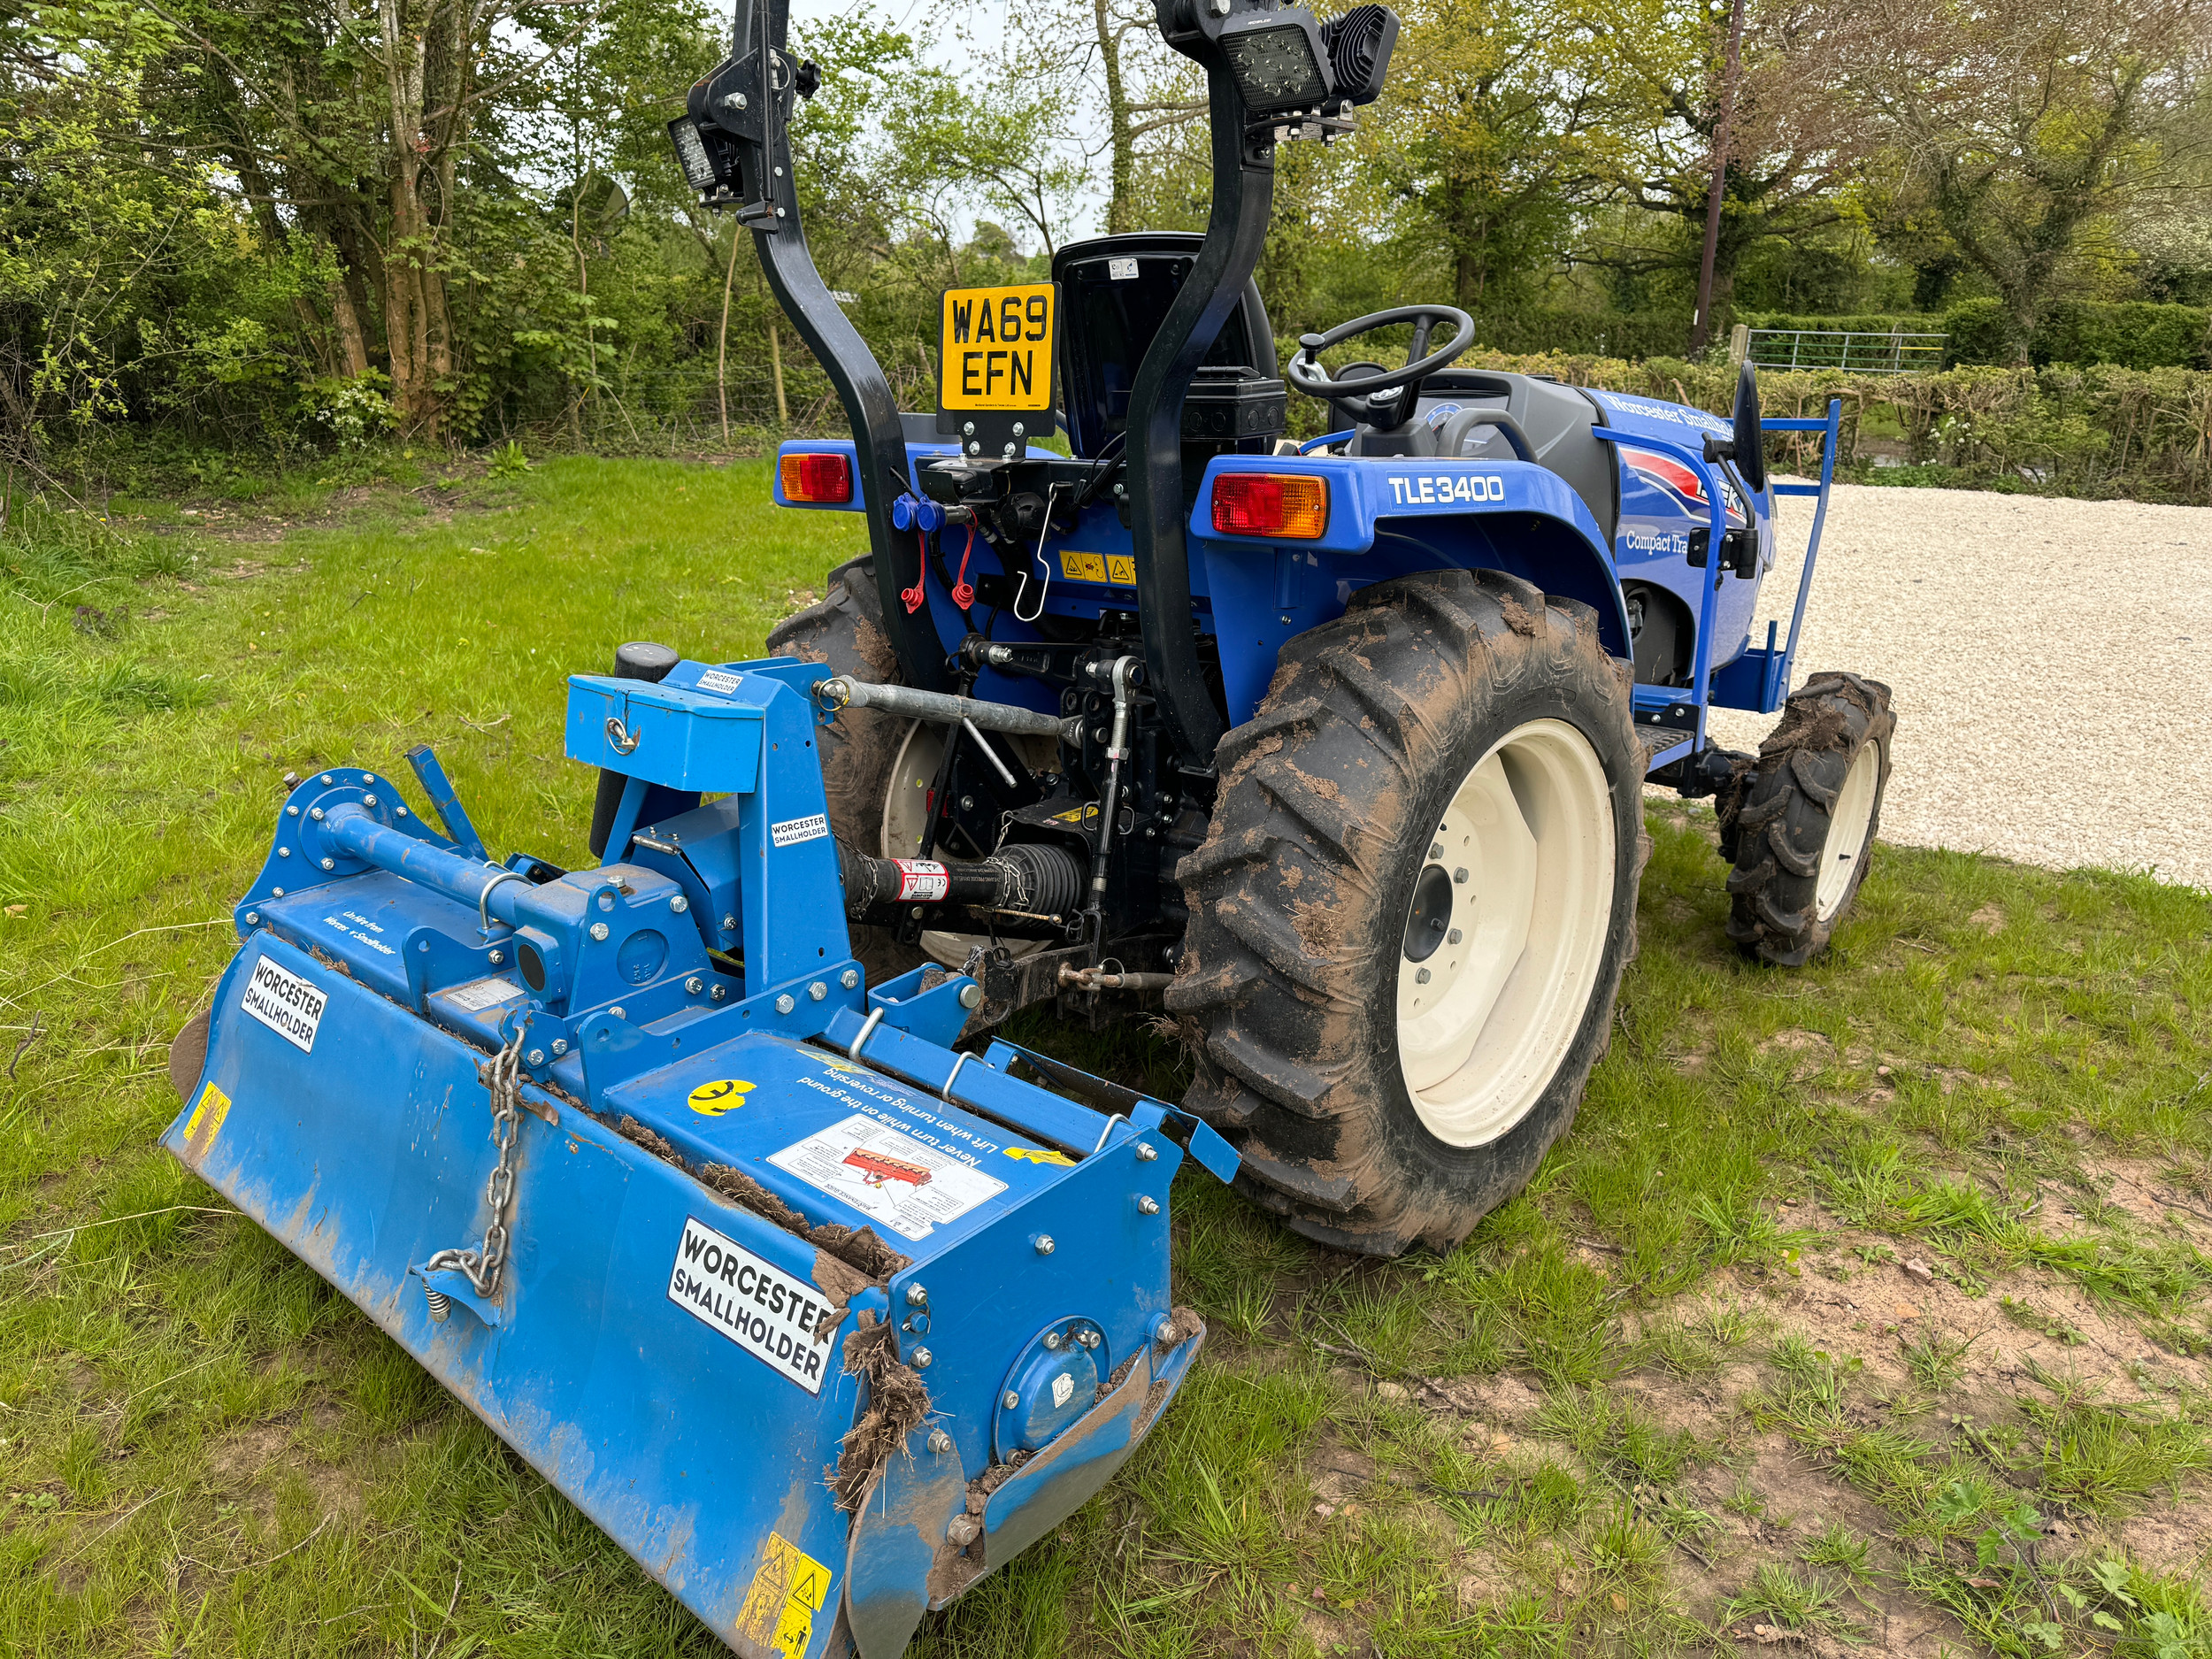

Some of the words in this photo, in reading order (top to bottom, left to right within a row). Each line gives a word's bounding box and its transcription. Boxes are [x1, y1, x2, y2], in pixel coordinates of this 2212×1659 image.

[952, 295, 1048, 344] WA69
[962, 349, 1033, 396] EFN
[1601, 393, 1682, 426] Worcester
[1387, 475, 1505, 504] TLE3400
[1625, 530, 1672, 556] Compact
[1672, 534, 1687, 554] Tra
[698, 679, 735, 692] SMALLHOLDER
[704, 672, 741, 685] WORCESTER
[772, 817, 825, 834] WORCESTER
[774, 826, 826, 844] SMALLHOLDER
[255, 962, 322, 1021] WORCESTER
[245, 987, 313, 1045] SMALLHOLDER
[796, 1076, 847, 1098] ground
[876, 1094, 894, 1102] or
[841, 1095, 863, 1109] the
[861, 1105, 879, 1116] on
[890, 1097, 938, 1124] turning
[877, 1112, 912, 1133] while
[935, 1119, 973, 1141] when
[910, 1128, 941, 1148] turn
[972, 1140, 999, 1154] Lift
[937, 1144, 982, 1168] Never
[684, 1229, 833, 1345] WORCESTER
[673, 1268, 821, 1381] SMALLHOLDER
